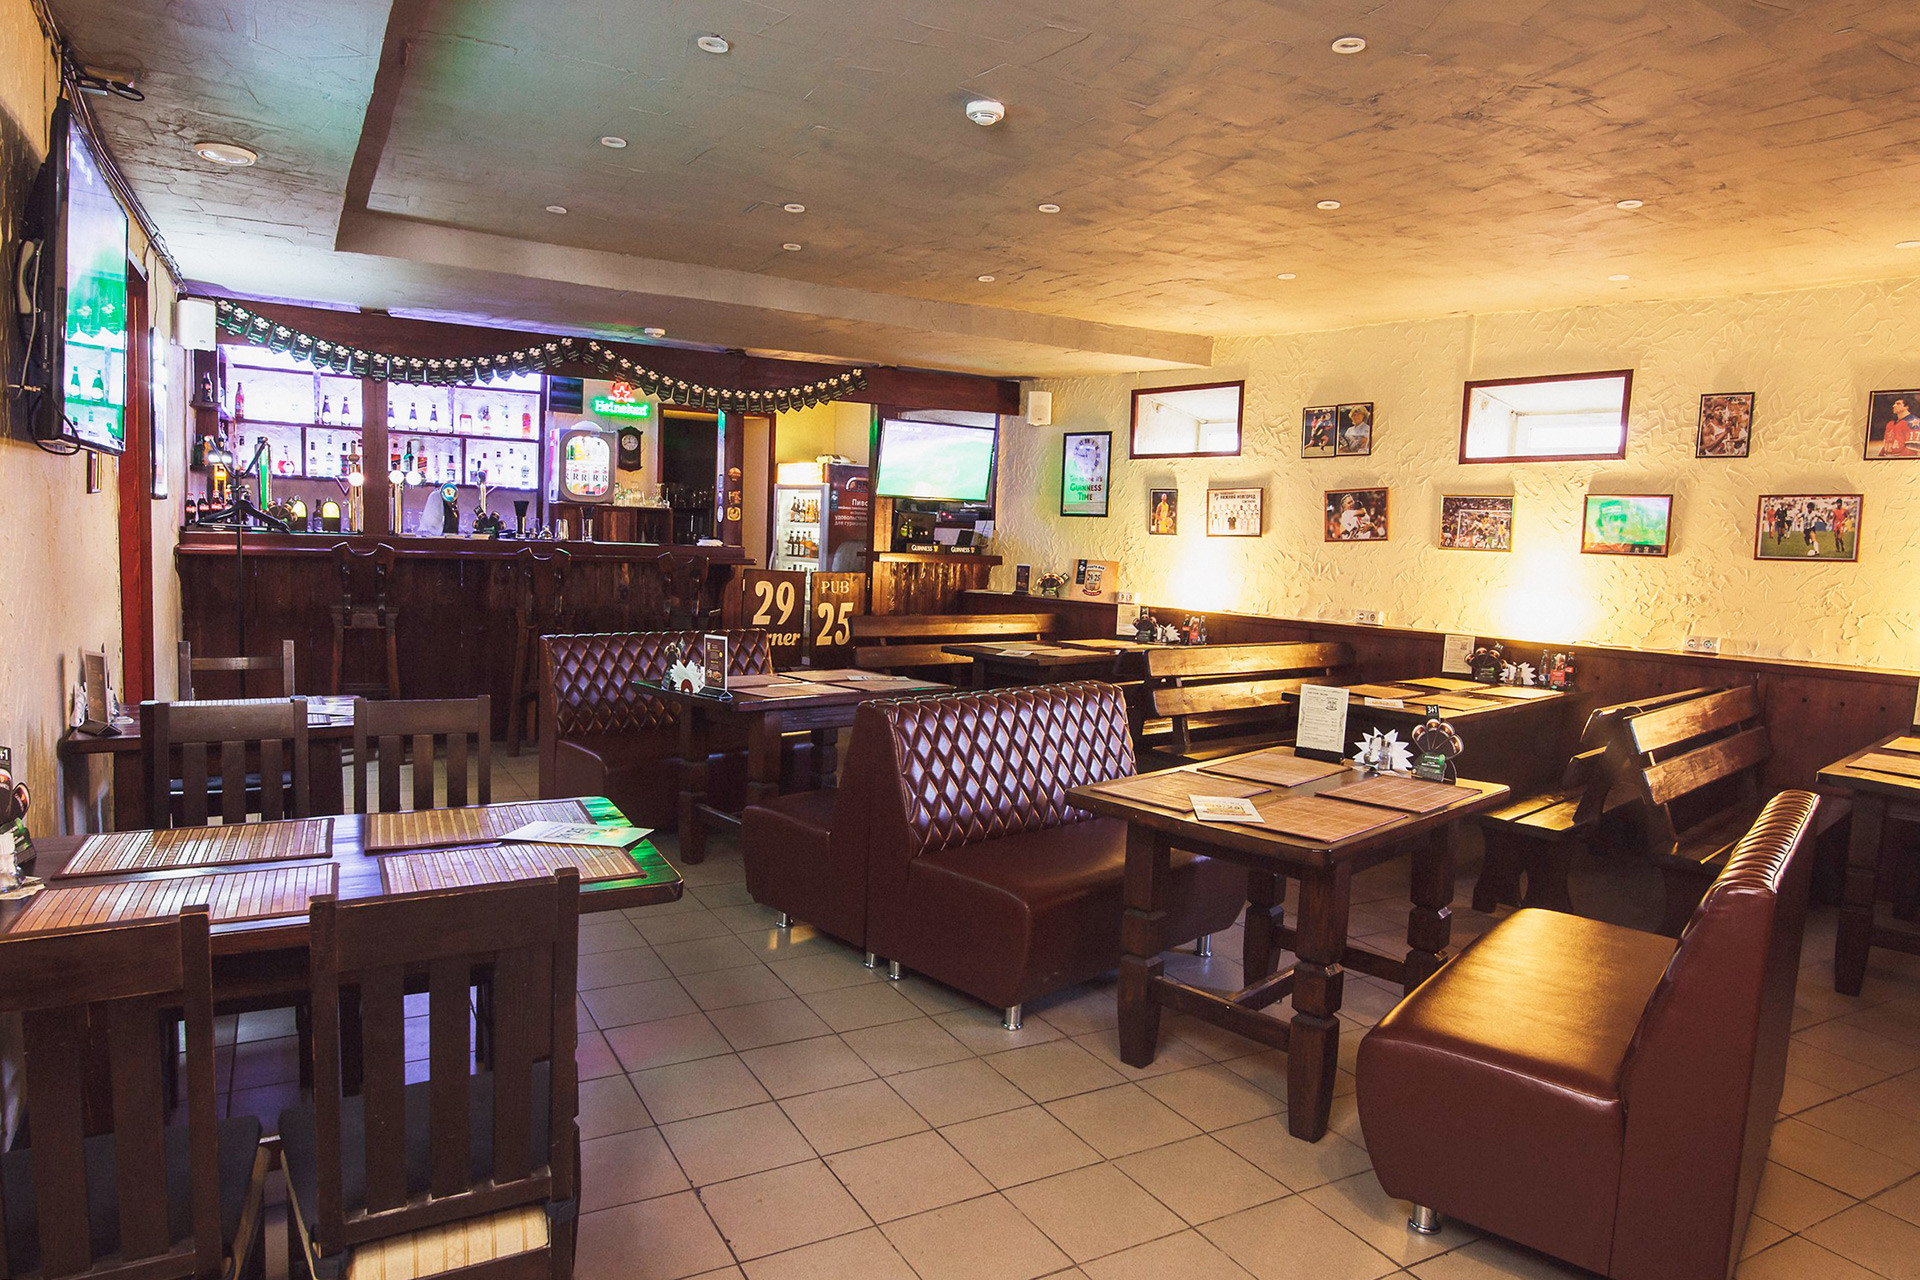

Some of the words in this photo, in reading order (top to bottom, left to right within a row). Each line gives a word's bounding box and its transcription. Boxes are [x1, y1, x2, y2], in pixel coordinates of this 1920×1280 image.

[911, 544, 933, 552] GUINNESS
[950, 545, 971, 553] GUINNESS
[821, 580, 850, 594] PUB
[752, 580, 795, 625] 29
[816, 602, 854, 646] 25
[1426, 705, 1438, 714] 3+1
[0, 749, 8, 760] +1
